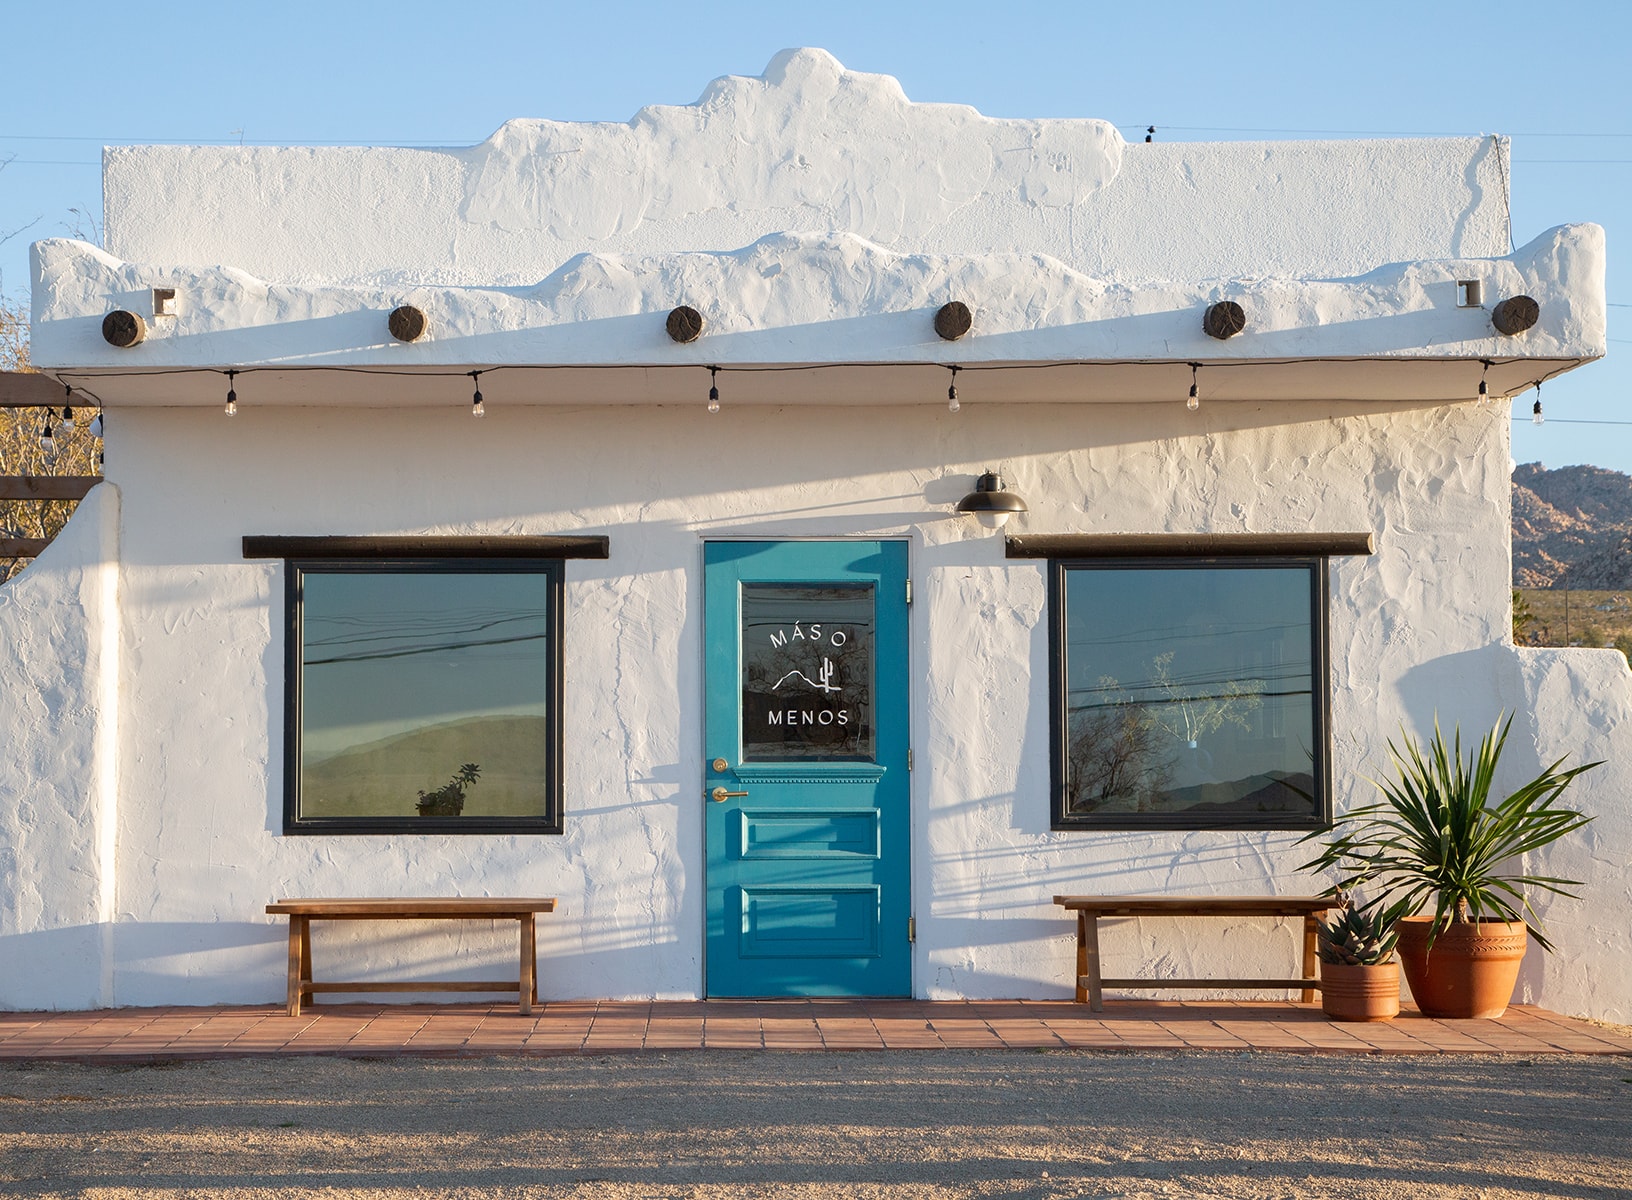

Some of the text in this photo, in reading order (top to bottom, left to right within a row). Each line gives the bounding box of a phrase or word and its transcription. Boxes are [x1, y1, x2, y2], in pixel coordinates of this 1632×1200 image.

[769, 620, 847, 648] MÁS O
[768, 710, 849, 725] MENOS
